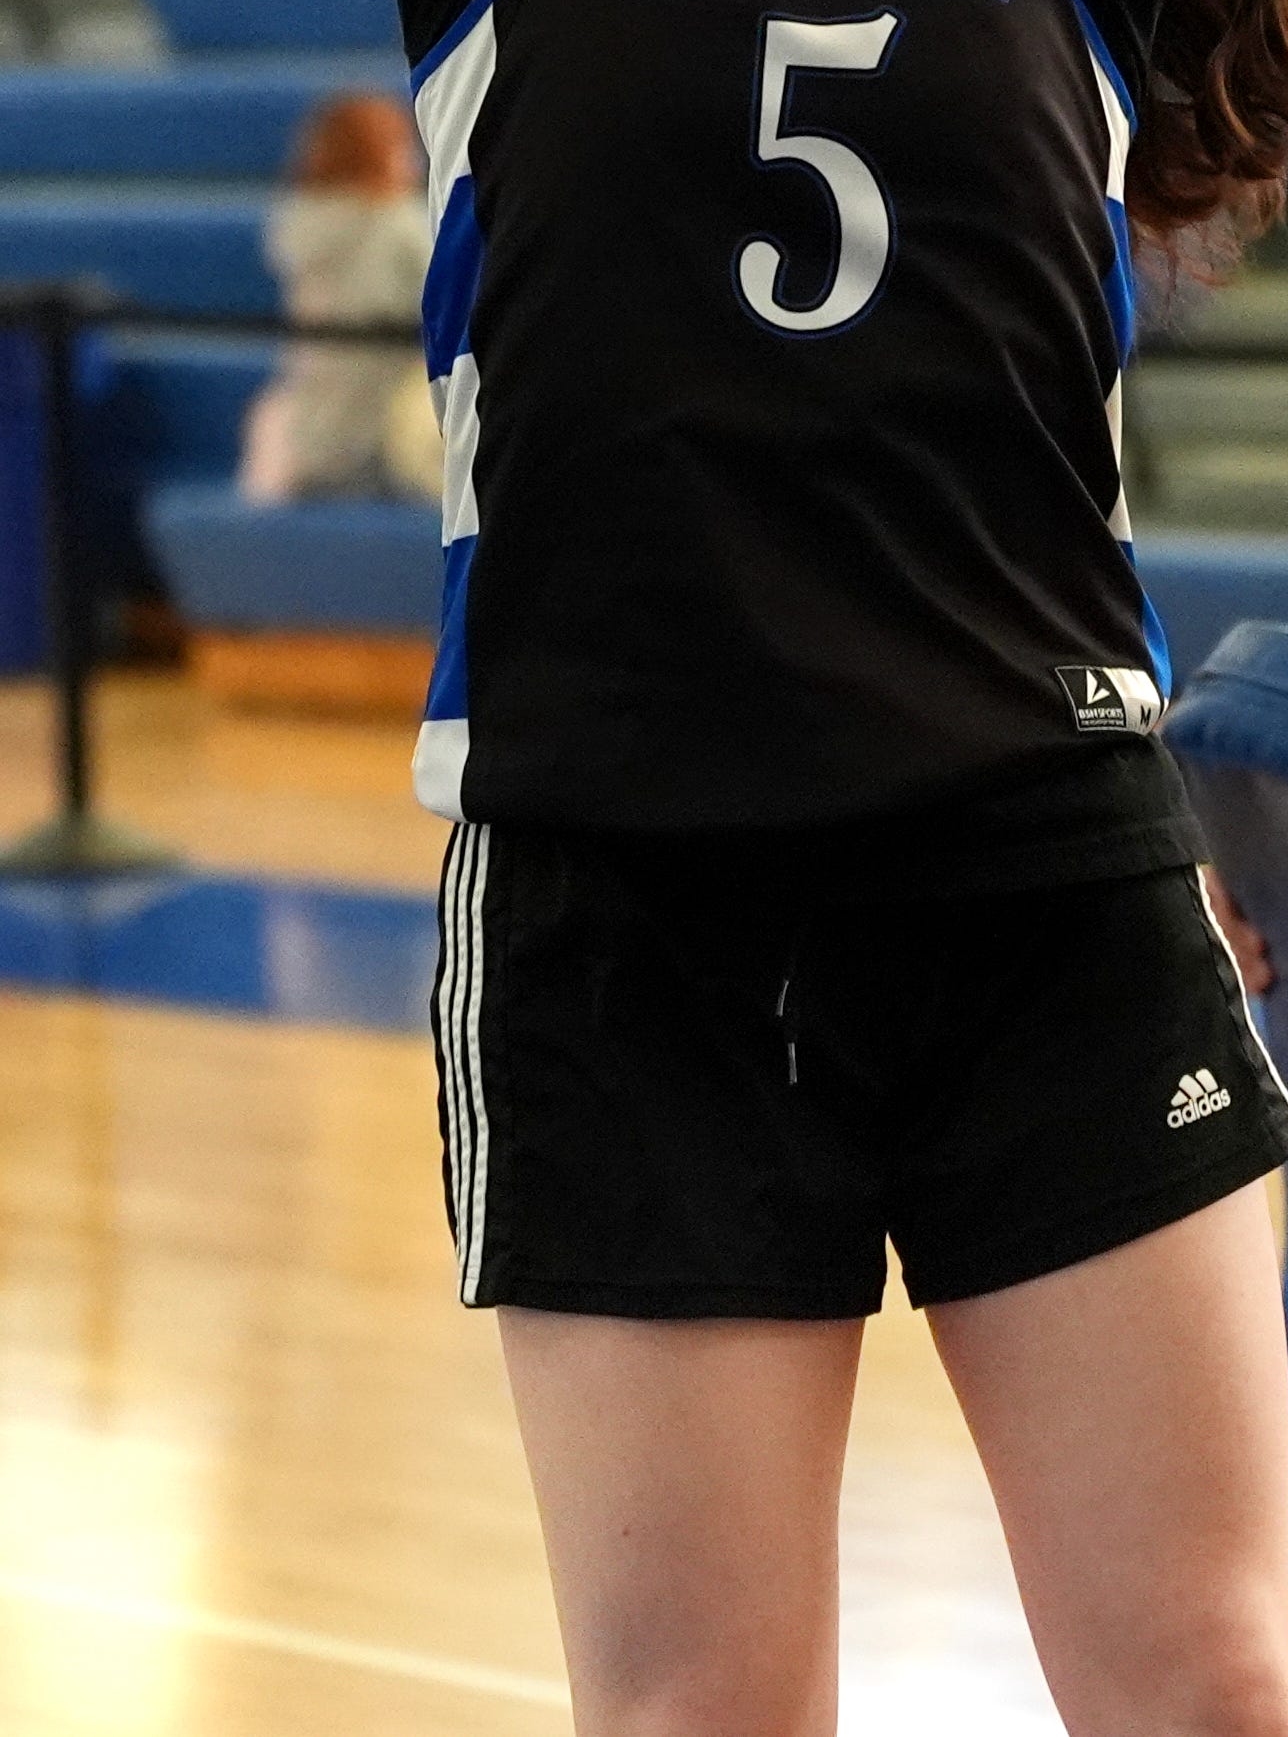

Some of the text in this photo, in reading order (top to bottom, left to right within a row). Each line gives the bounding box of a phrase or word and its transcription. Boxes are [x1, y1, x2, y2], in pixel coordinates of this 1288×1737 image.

[735, 9, 902, 335] 5
[1140, 704, 1151, 728] M
[1167, 1088, 1231, 1128] adidas
